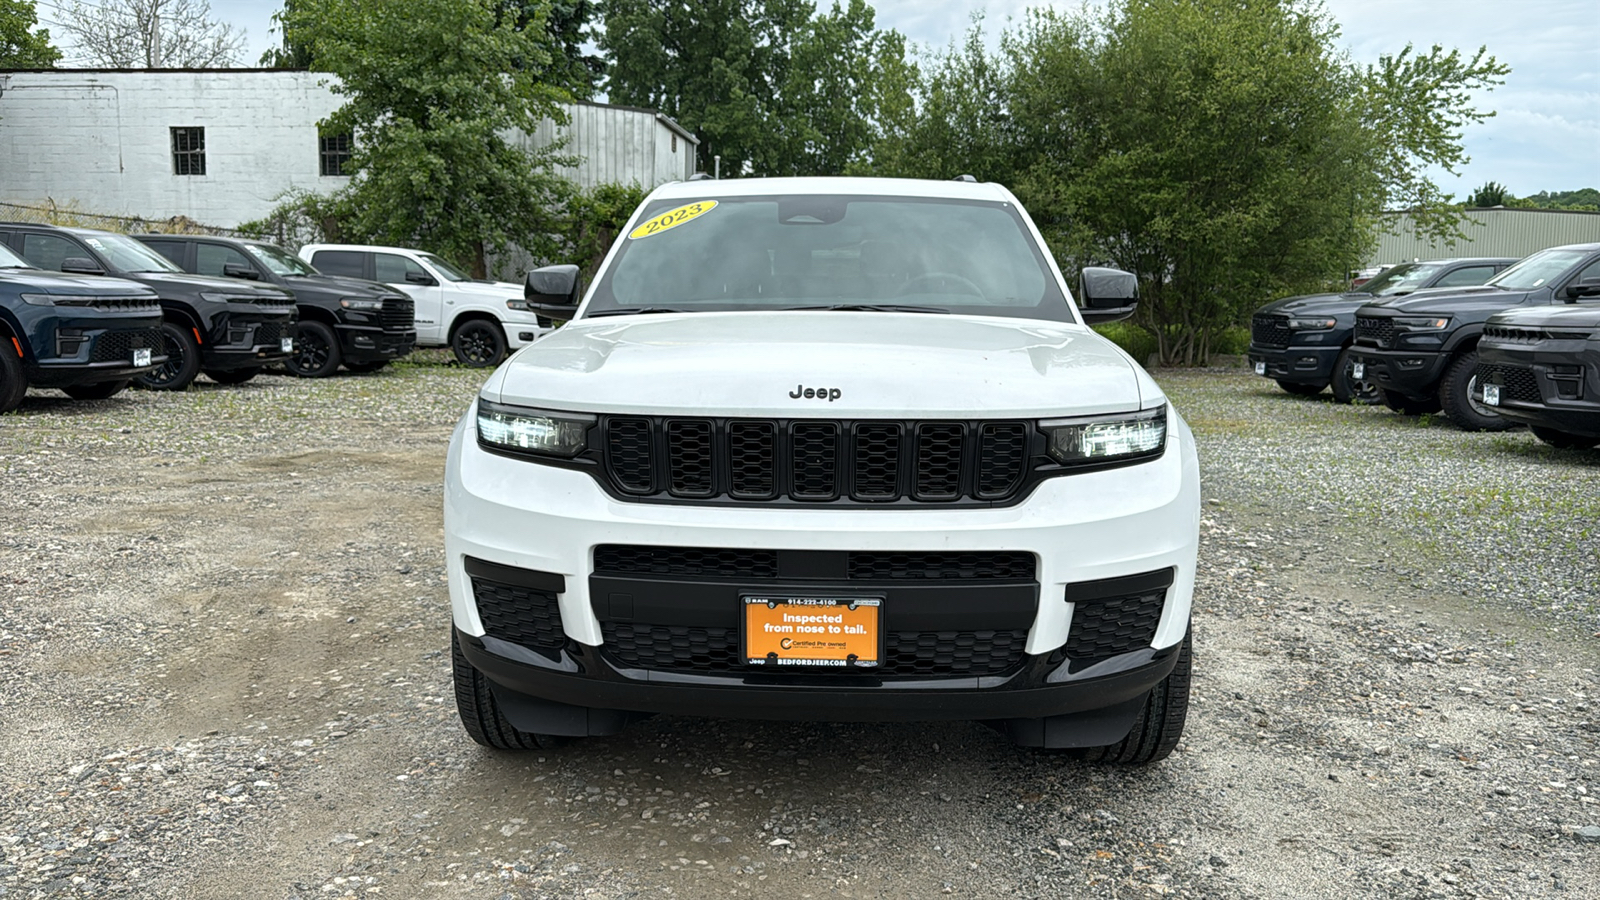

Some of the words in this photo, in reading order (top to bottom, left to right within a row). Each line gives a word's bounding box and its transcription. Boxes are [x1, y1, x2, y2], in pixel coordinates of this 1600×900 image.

[646, 204, 703, 234] 2023
[789, 384, 842, 402] Jeep
[783, 613, 843, 625] Inspected
[764, 623, 793, 633] from
[796, 625, 825, 634] nose
[828, 625, 841, 634] to
[844, 624, 868, 634] tail.
[777, 659, 847, 667] BEDFORDJEEP.COM
